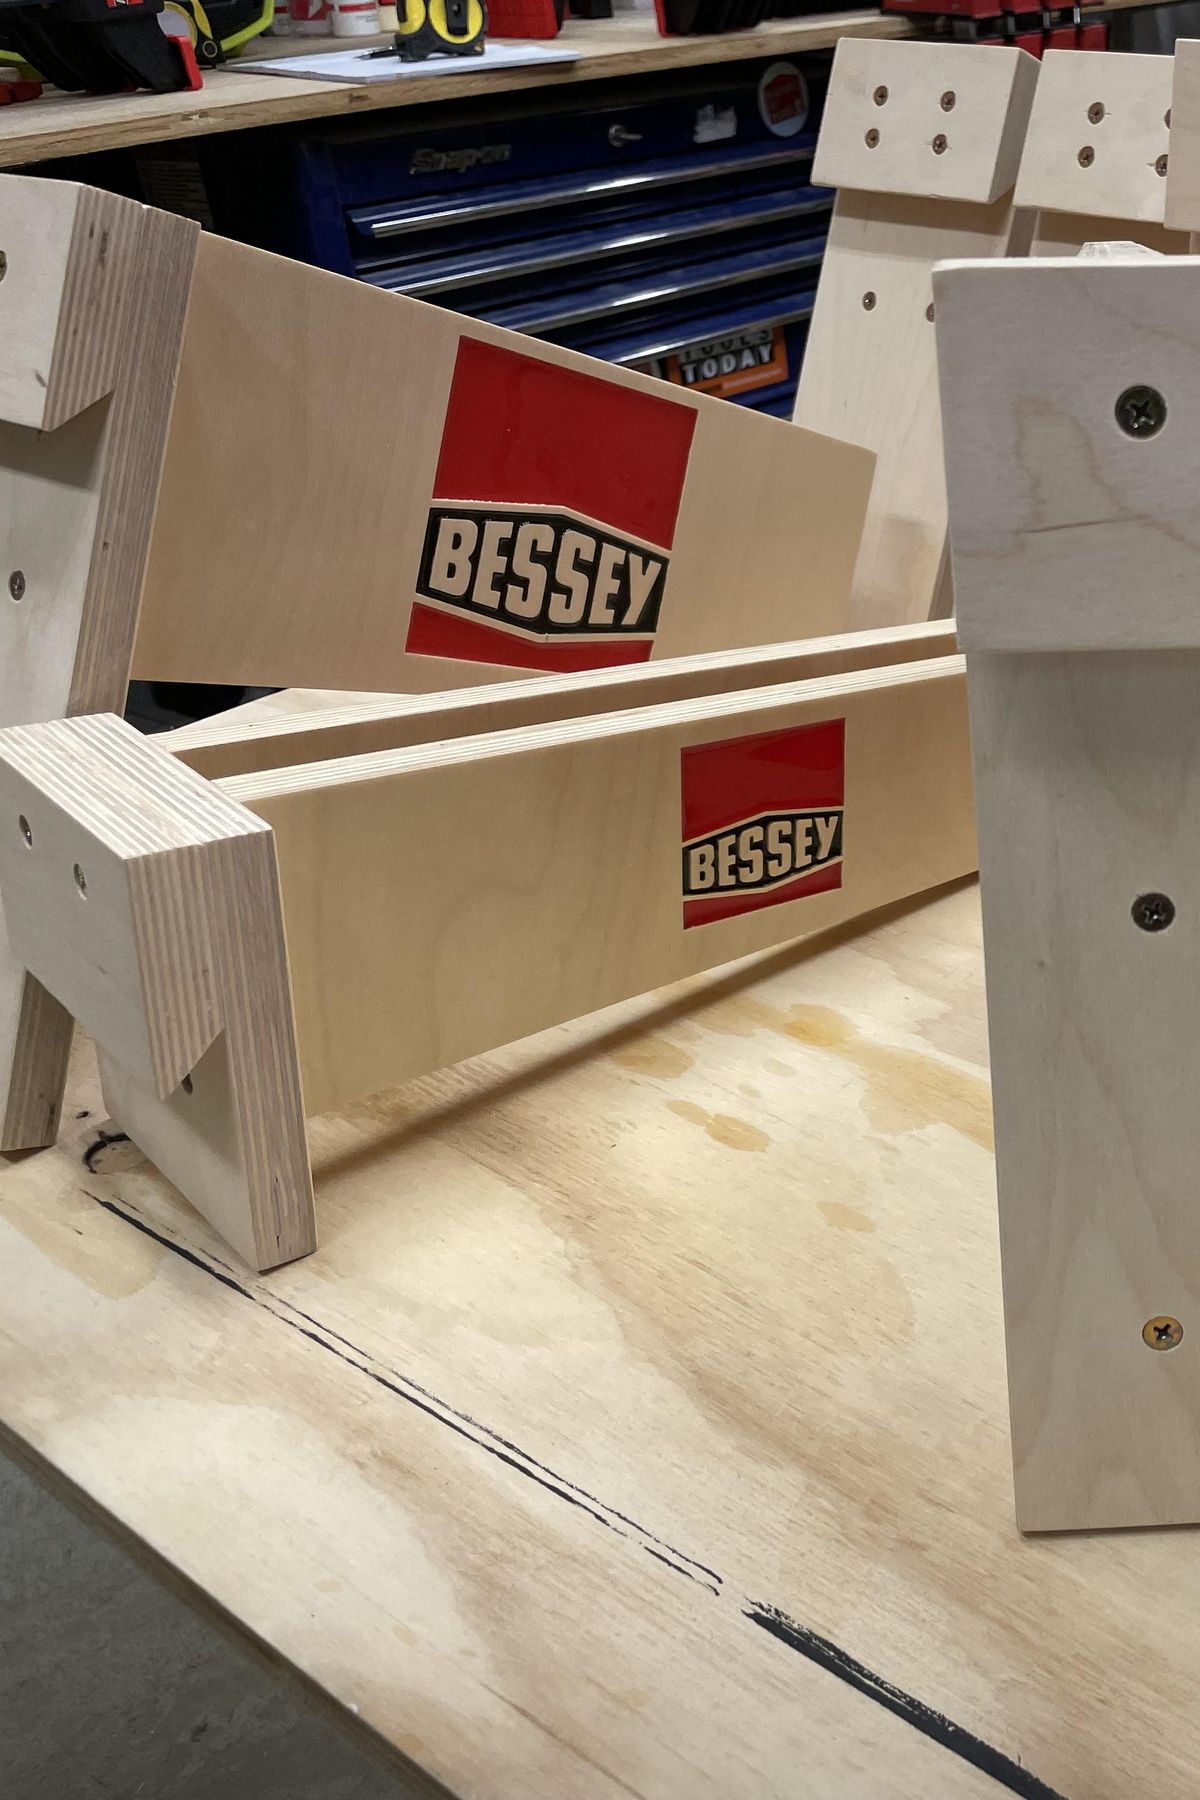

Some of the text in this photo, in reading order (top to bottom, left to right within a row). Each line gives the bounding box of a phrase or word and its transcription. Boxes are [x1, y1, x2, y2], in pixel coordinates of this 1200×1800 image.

[682, 343, 773, 384] TODAY
[428, 516, 662, 626] BESSEY
[689, 815, 839, 891] BESSEY
